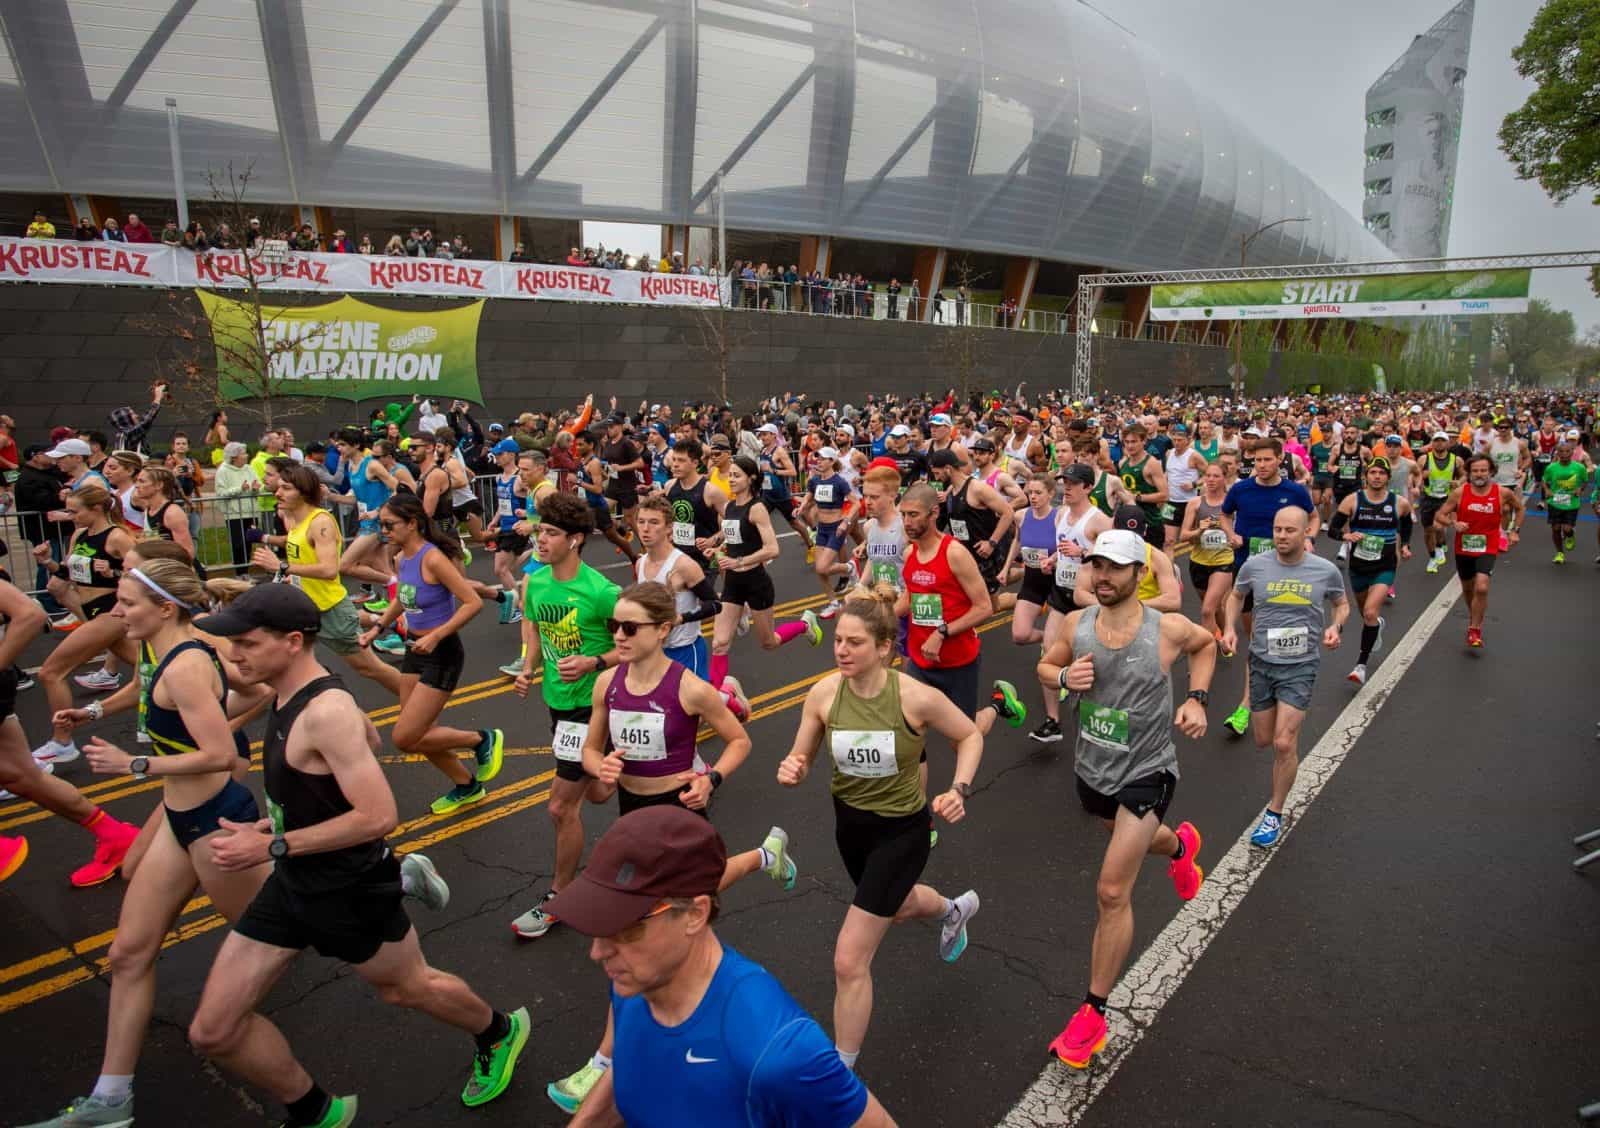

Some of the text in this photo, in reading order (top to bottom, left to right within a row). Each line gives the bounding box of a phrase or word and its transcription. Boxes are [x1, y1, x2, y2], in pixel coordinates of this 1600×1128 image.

[0, 243, 152, 277] KRUSTEAZ
[370, 261, 486, 289] KRUSTEAZ
[517, 269, 614, 296] KRUSTEAZ
[641, 277, 720, 300] KRUSTEAZ
[1281, 279, 1365, 304] START
[1303, 304, 1341, 315] KRUSTEAZ
[258, 320, 380, 350] EUGENE
[267, 350, 442, 381] MARATHON
[868, 543, 897, 555] LINFIELD
[1266, 582, 1313, 593] BEASTS
[915, 604, 933, 616] 1171
[1275, 636, 1300, 649] 4232
[1088, 715, 1116, 736] 1467
[559, 733, 581, 749] 4241
[619, 727, 651, 745] 4615
[847, 748, 881, 764] 4510
